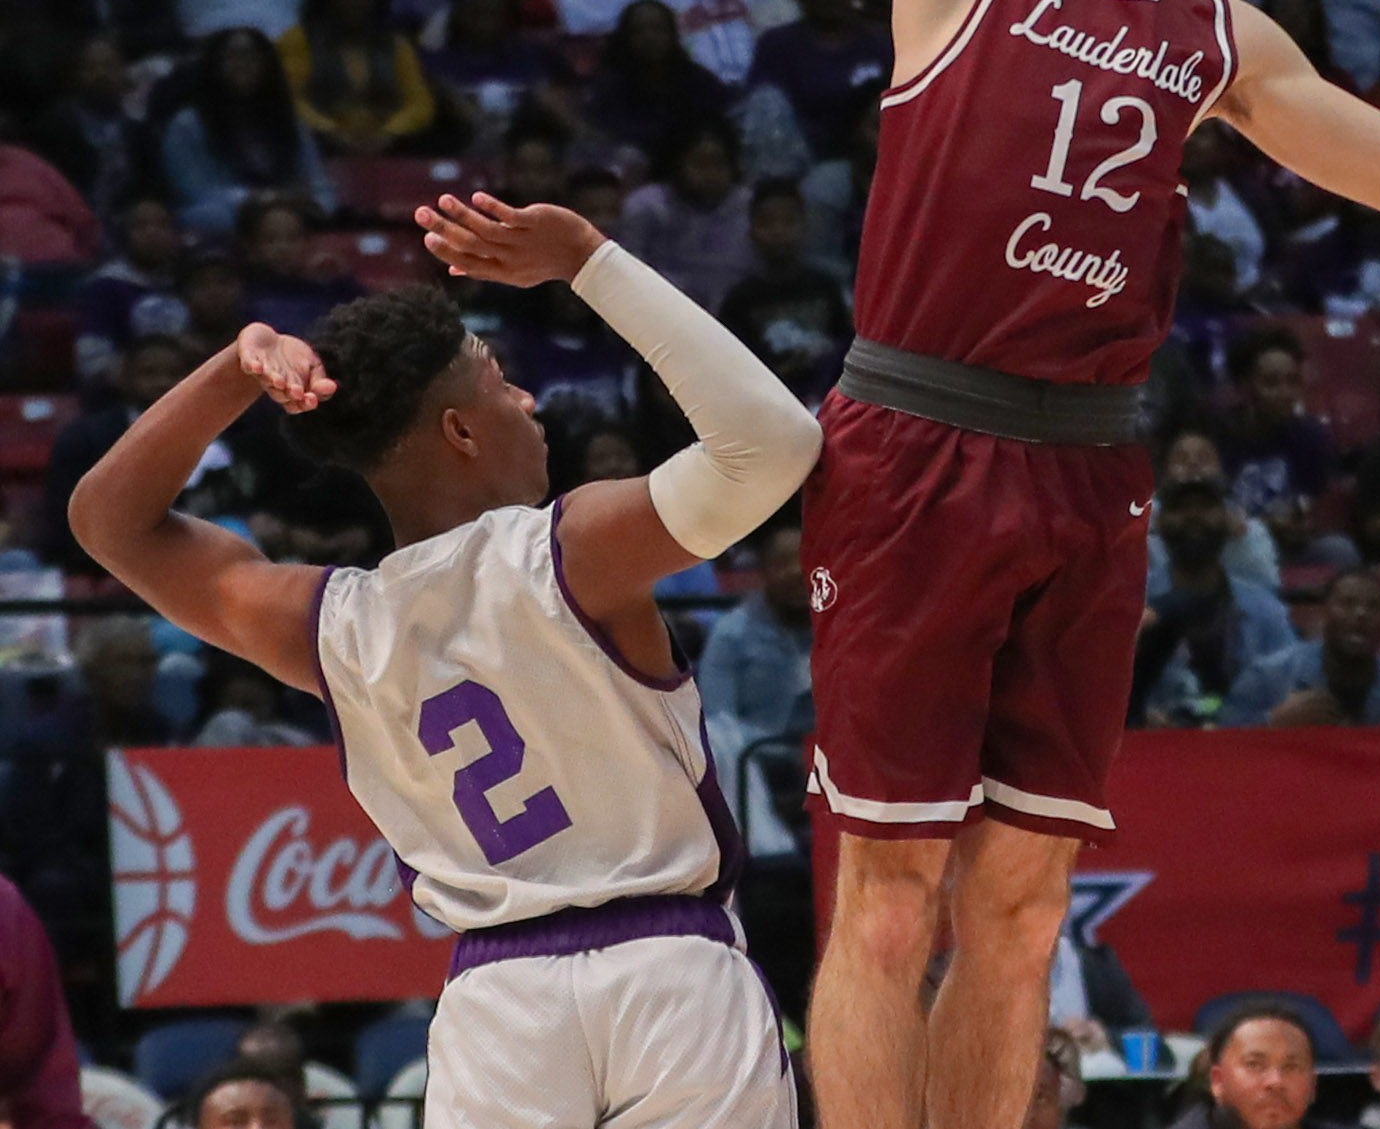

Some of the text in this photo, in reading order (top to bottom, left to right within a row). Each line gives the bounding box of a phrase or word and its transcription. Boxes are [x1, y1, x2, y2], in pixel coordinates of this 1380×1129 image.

[1030, 78, 1158, 213] 12
[1005, 212, 1128, 309] County
[418, 679, 573, 866] 2
